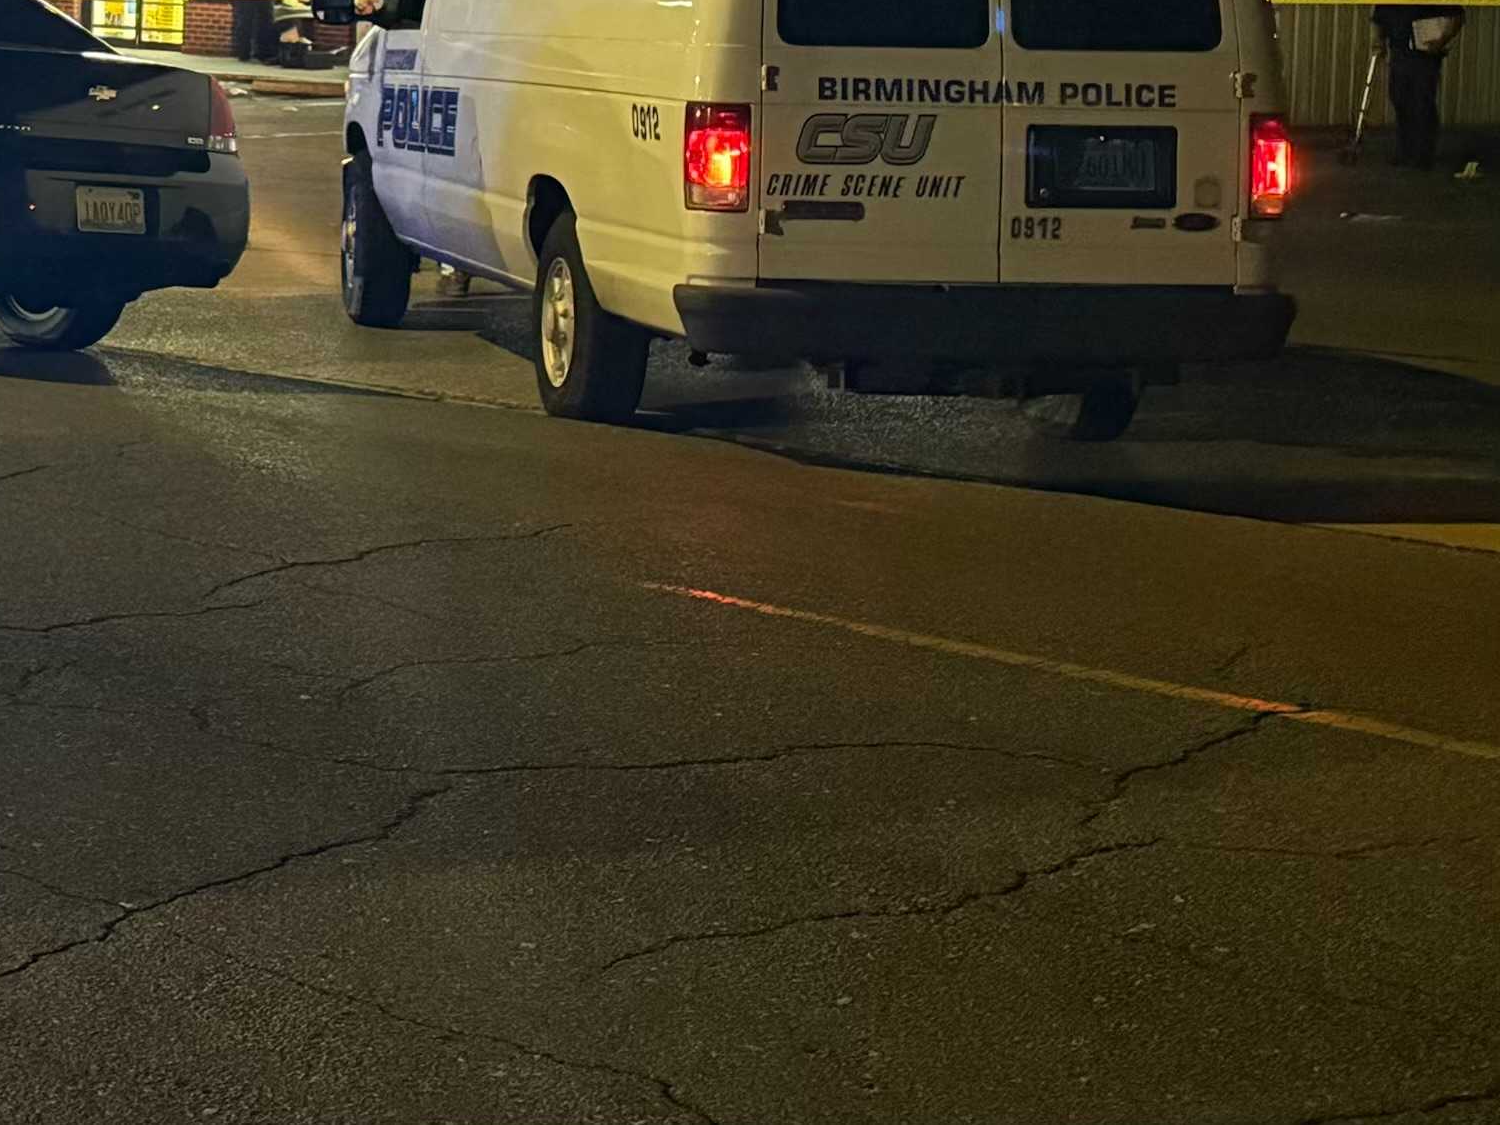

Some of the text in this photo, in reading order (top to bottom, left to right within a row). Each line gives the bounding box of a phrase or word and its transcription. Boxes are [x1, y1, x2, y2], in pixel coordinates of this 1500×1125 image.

[818, 76, 1177, 107] BIRMINGHAM POLICE
[377, 83, 460, 157] POLICE
[632, 103, 661, 141] 0912
[796, 113, 938, 166] CSU
[766, 174, 966, 198] CRIME SCENE UNIT
[1010, 216, 1062, 240] 0912
